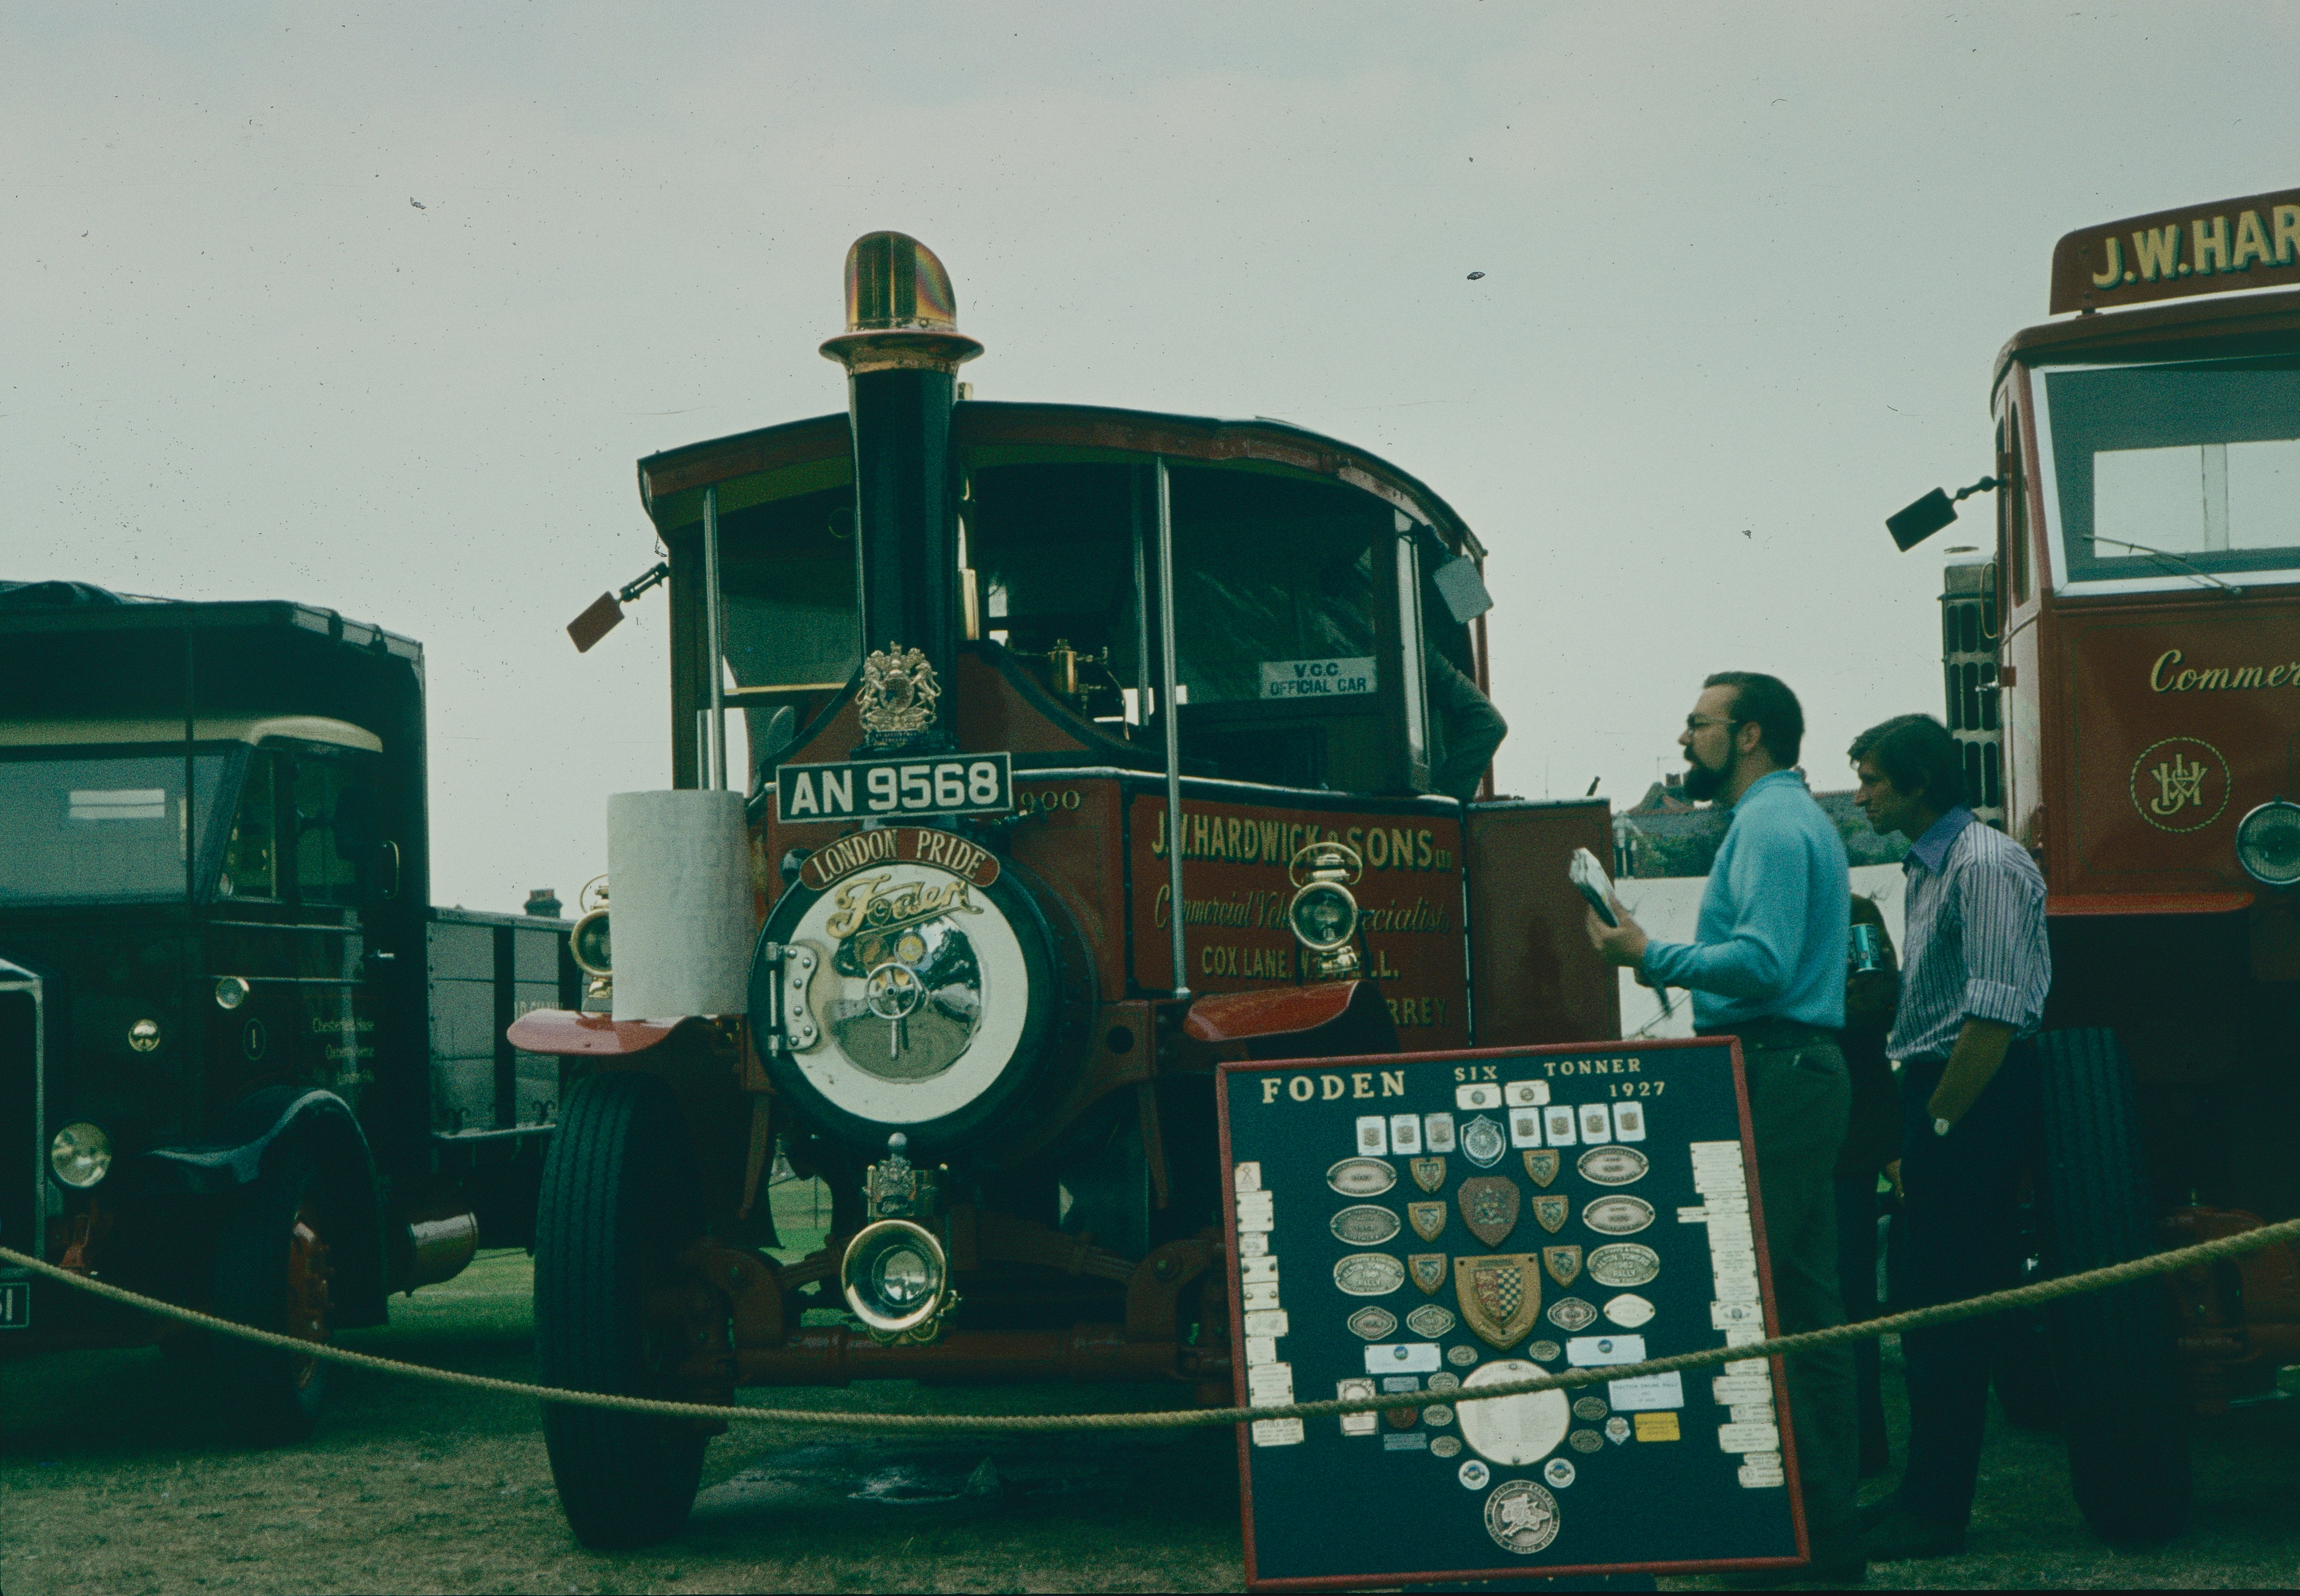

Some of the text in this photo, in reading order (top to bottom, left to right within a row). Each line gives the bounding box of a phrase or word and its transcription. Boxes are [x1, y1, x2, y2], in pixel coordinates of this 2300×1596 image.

[1270, 677, 1366, 695] OFFICIAL CAR
[790, 762, 999, 815] AN 9568
[812, 829, 988, 884] LONDON PRIDE
[1346, 827, 1432, 867] SONS
[826, 873, 984, 939] Foden
[1155, 883, 1254, 928] Cmmercial
[1202, 945, 1237, 975] COX
[1261, 1058, 1641, 1103] FODEN SIX TONNER
[1609, 1082, 1665, 1098] 1927
